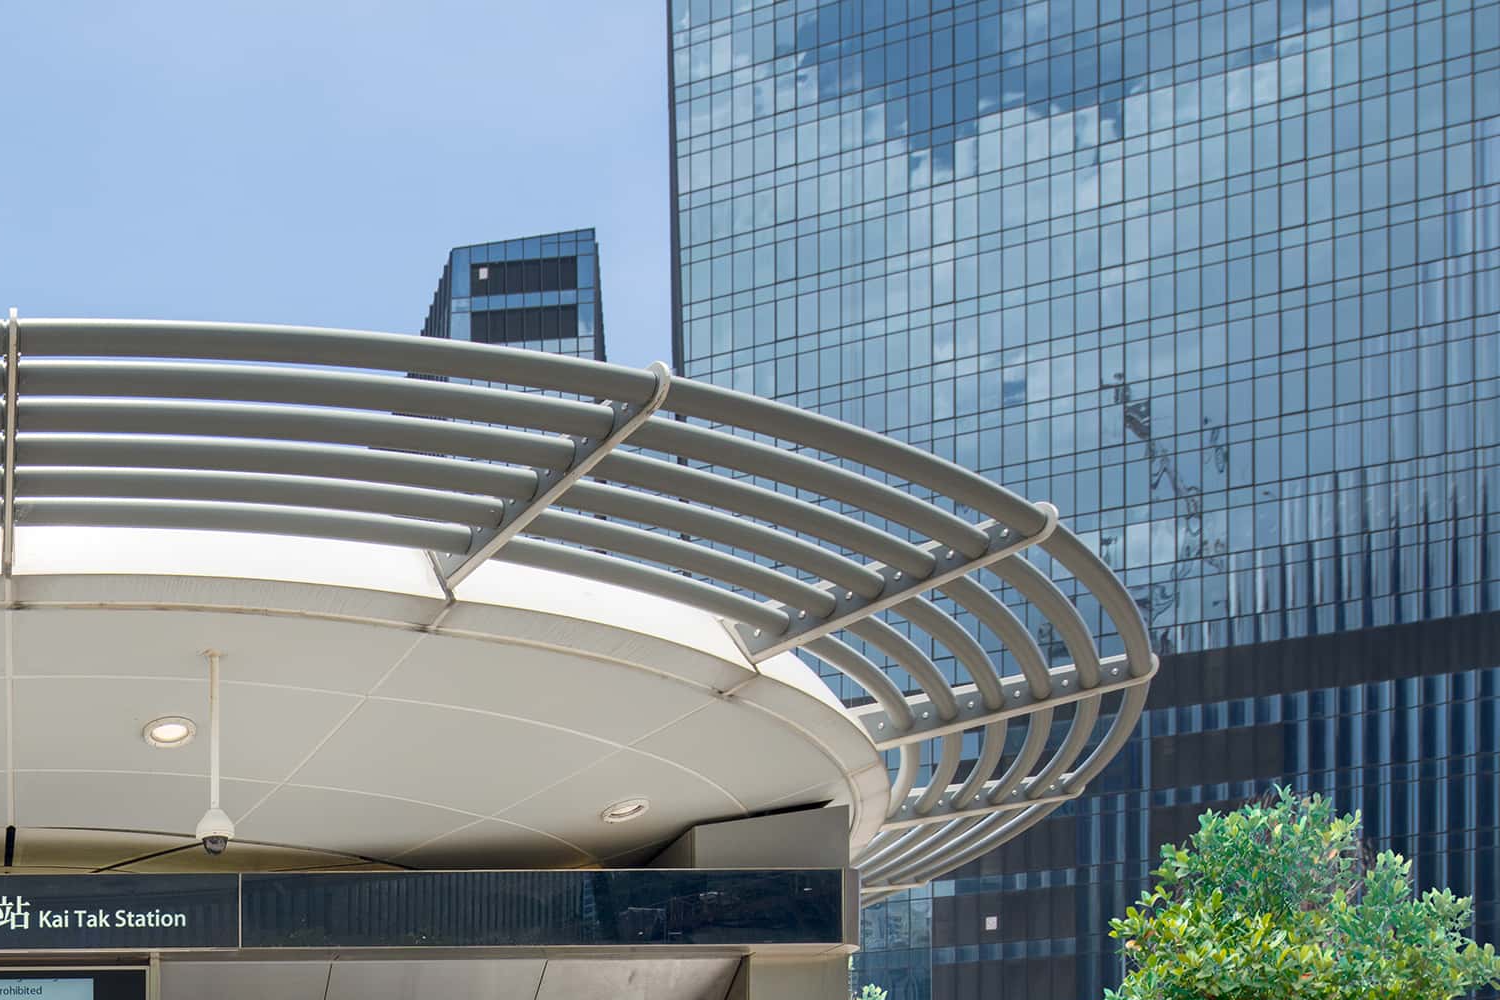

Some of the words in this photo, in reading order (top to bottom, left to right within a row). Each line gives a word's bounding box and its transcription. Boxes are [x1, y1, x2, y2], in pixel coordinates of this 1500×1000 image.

[38, 909, 69, 928] Kai
[74, 909, 110, 928] Tak
[115, 908, 187, 928] Station
